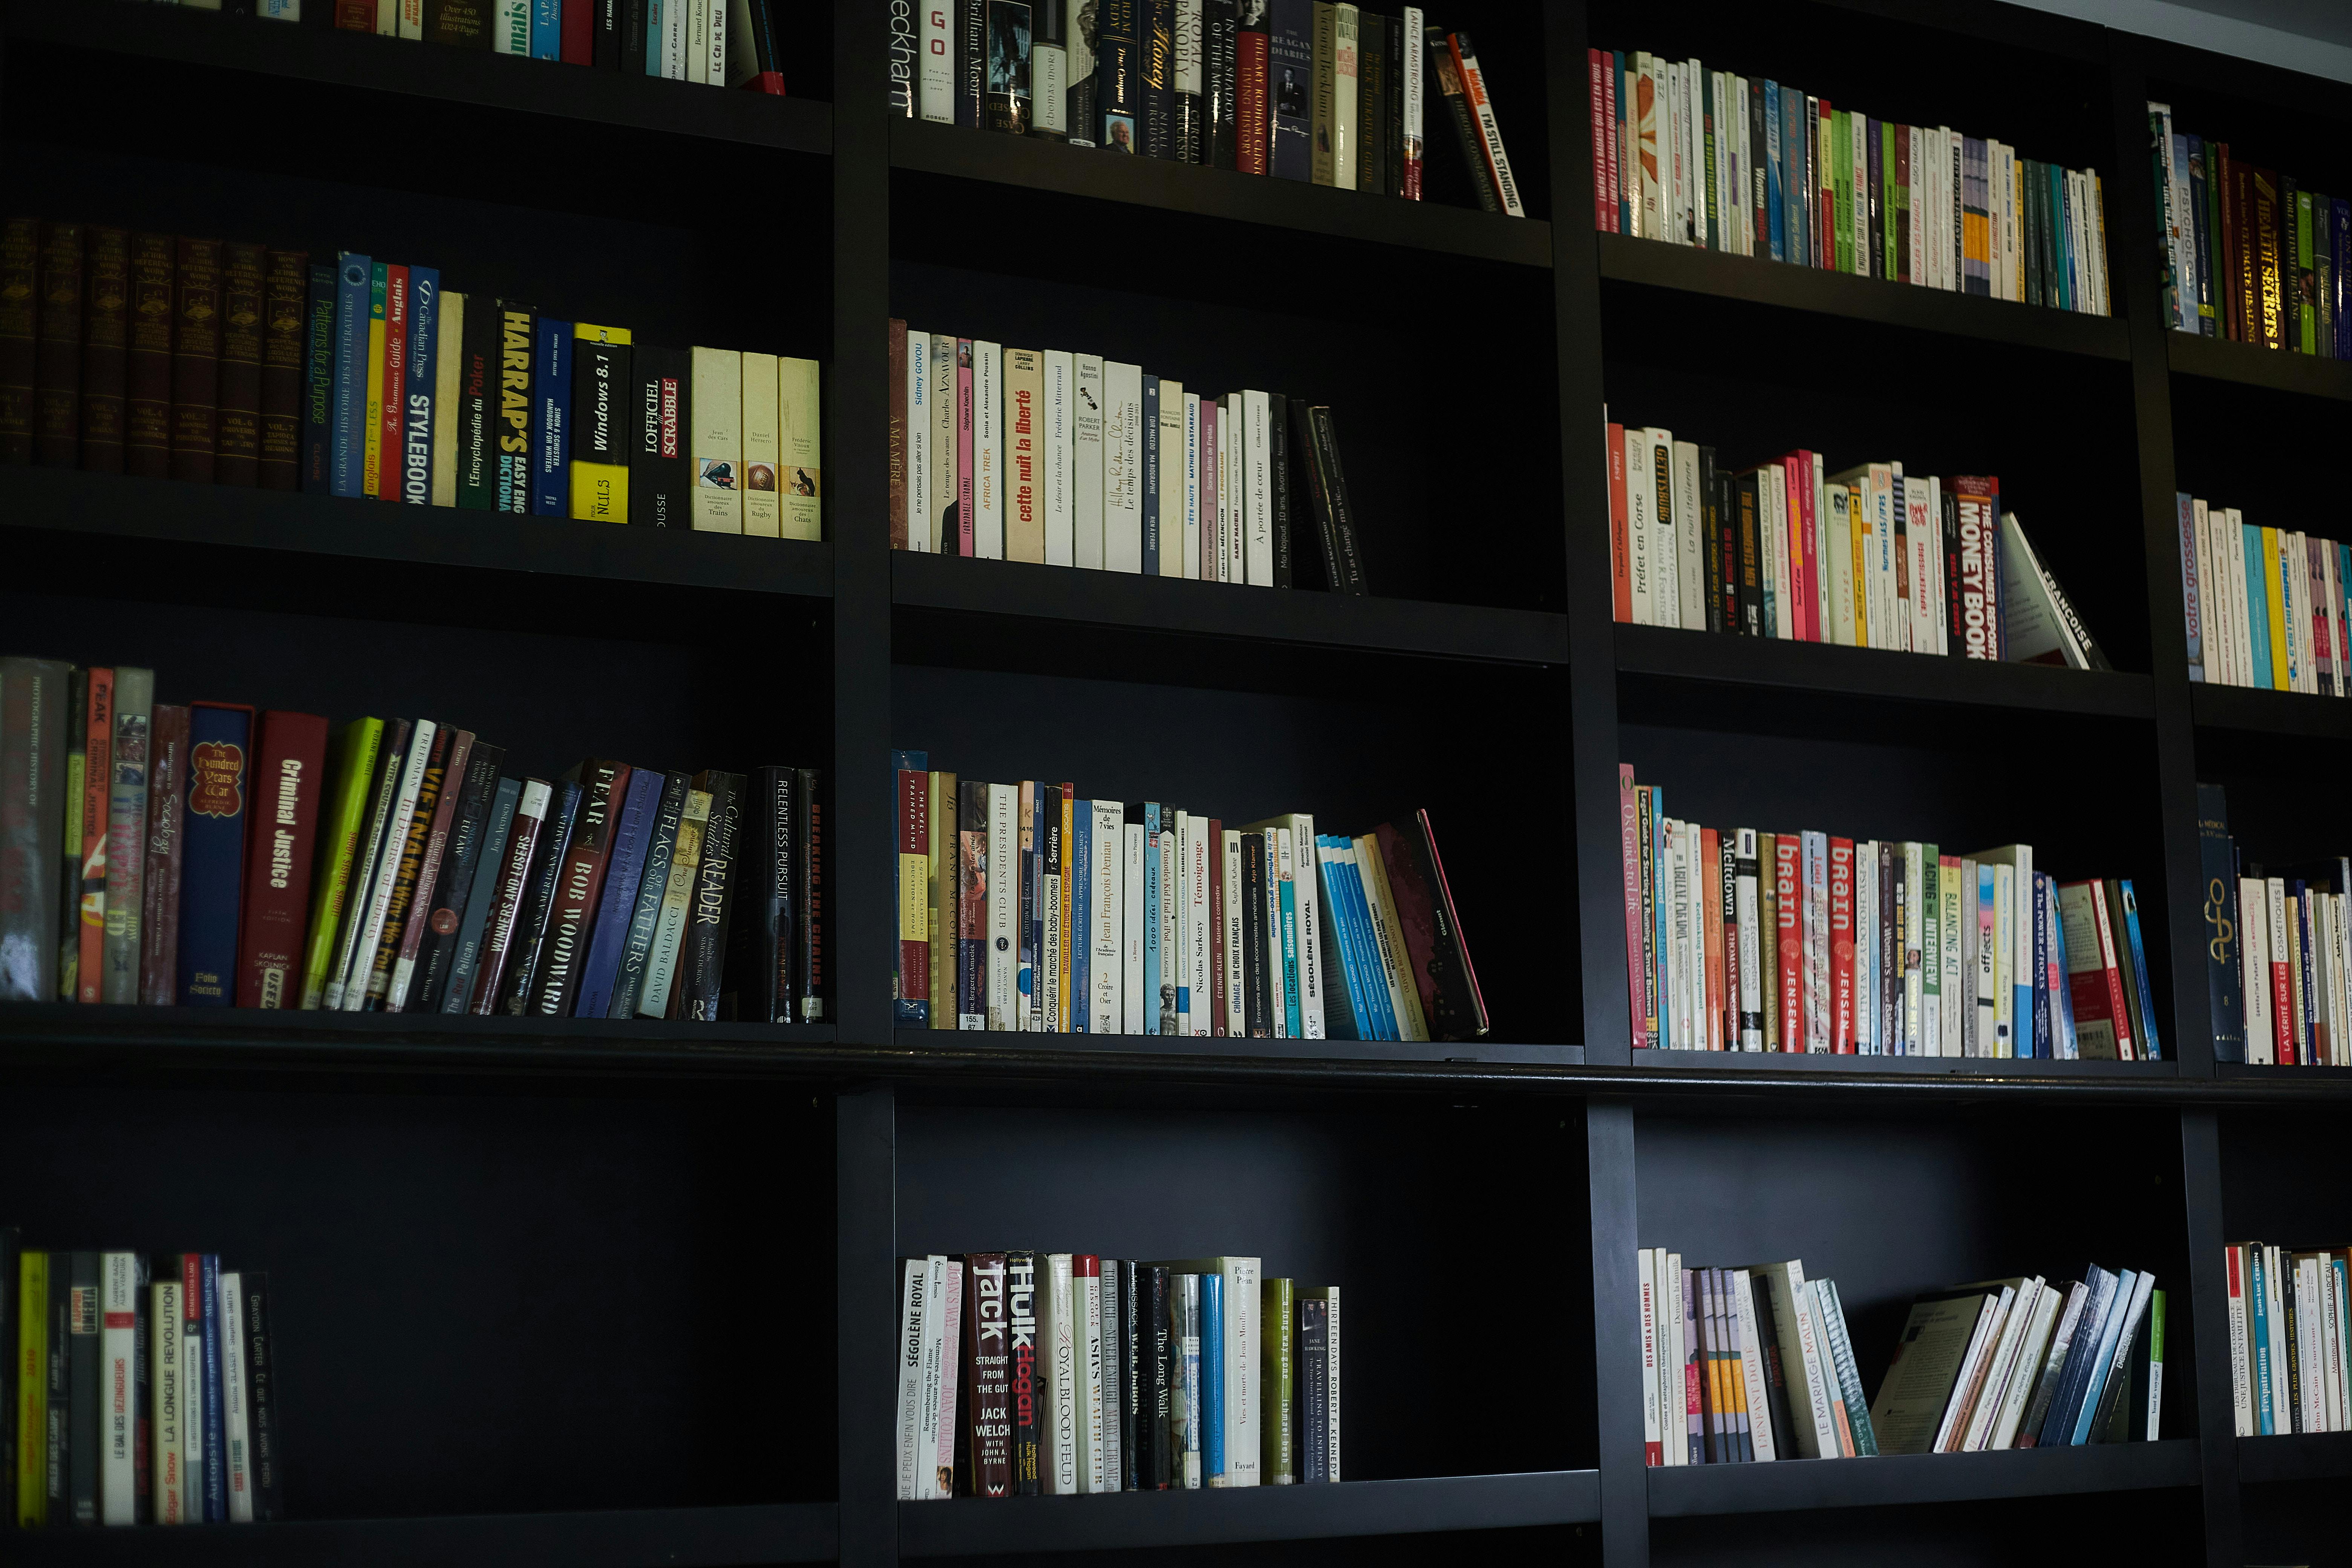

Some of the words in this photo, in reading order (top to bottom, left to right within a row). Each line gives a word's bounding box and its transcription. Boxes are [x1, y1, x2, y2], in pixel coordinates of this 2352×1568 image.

[714, 9, 723, 28] DIEU
[715, 32, 722, 41] DE
[1409, 10, 1419, 39] LANCE
[1271, 37, 1311, 51] REAGAN
[1271, 47, 1311, 61] DIARIES
[713, 63, 721, 72] LE
[1242, 67, 1251, 106] LIVING
[1408, 41, 1419, 101] ARMSTRONG
[1242, 110, 1251, 157] HISTORY
[1485, 126, 1503, 156] STILL
[1493, 156, 1519, 209] STANDING
[2182, 187, 2195, 294] PSYCHOLOGY
[2258, 199, 2273, 263] HEALTH
[391, 278, 404, 325] Anglais
[2262, 265, 2278, 338] SECRETS
[390, 337, 401, 369] Guide
[596, 355, 609, 379] 8.1
[386, 371, 399, 414] Grammar
[468, 354, 485, 397] Poker
[500, 310, 531, 453] HARRAP'S
[475, 398, 482, 407] du
[594, 382, 609, 452] Windows
[645, 380, 658, 453] L'OFFICIEL
[663, 380, 677, 456] SCRABBLE
[1015, 390, 1031, 436] liberté
[387, 416, 398, 435] The
[468, 410, 484, 487] L'Encyclopédie
[1016, 438, 1031, 452] la
[1018, 455, 1032, 482] nuit
[1656, 447, 1671, 524] GETTYSBURG
[597, 479, 610, 516] NULS
[708, 508, 728, 517] Trains
[1019, 485, 1032, 522] cette
[1125, 500, 1134, 510] Le
[1256, 488, 1263, 499] de
[1635, 494, 1644, 530] Corse
[751, 510, 772, 519] Rugby
[1256, 503, 1266, 533] portée
[1254, 534, 1264, 544] À
[1638, 535, 1645, 551] en
[1959, 501, 1983, 591] MONEY
[2181, 500, 2198, 589] grossesse
[1637, 555, 1646, 594] Préfet
[1964, 592, 1987, 660] BOOK
[2185, 593, 2199, 638] votre
[276, 759, 302, 826] Criminal
[586, 767, 615, 825] FEAR
[778, 780, 788, 851] RELENTLESS
[270, 827, 296, 888] Justice
[651, 813, 677, 869] FLAGS
[812, 804, 821, 886] BREAKING
[1049, 826, 1058, 863] Serrière
[568, 862, 593, 901] BOB
[696, 858, 727, 925] READER
[777, 852, 788, 901] PURSUIT
[1194, 841, 1203, 907] Témoignage
[1723, 838, 1736, 916] Meltdown
[490, 902, 514, 953] WINNERS
[504, 876, 521, 901] AND
[513, 835, 531, 877] LOSERS
[812, 891, 821, 918] THE
[1049, 878, 1060, 921] baby-boomers
[626, 894, 658, 974] FATHERS
[1048, 922, 1057, 934] des
[1195, 921, 1204, 957] Sarkozy
[2274, 888, 2285, 961] COSMÉTIQUES
[541, 907, 582, 1016] WOODWARD
[651, 967, 665, 1004] DAVID
[660, 906, 679, 963] BALDACCI
[812, 923, 821, 986] CHAINS
[1048, 936, 1057, 965] marché
[1305, 939, 1315, 997] SÉGOLÈNE
[1049, 966, 1055, 977] le
[1046, 980, 1059, 1023] Conquérir
[1786, 969, 1797, 1030] JENSEN
[2280, 982, 2288, 1003] SUR
[2281, 1004, 2290, 1038] VÉRITÉ
[2283, 1041, 2290, 1052] LA
[912, 1272, 924, 1307] ROYAL
[1234, 1266, 1254, 1275] Pierre
[2326, 1263, 2334, 1300] MARCEAU
[1009, 1266, 1036, 1350] Hulk
[1643, 1282, 1651, 1312] HOMMES
[163, 1286, 175, 1365] REVOLUTION
[908, 1309, 921, 1367] SÉGOLÈNE
[1156, 1329, 1167, 1352] The
[1801, 1311, 1816, 1355] MALIN
[975, 1356, 1008, 1365] STRAIGHT
[982, 1370, 1004, 1379] FROM
[1155, 1354, 1167, 1386] Long
[2330, 1337, 2339, 1374] Menteuse
[165, 1370, 175, 1423] LONGUE
[977, 1384, 992, 1393] THE
[994, 1384, 1009, 1393] GUT
[1012, 1345, 1035, 1426] Hogan
[1158, 1388, 1167, 1418] Walk
[1808, 1355, 1826, 1419] MARIAGE
[975, 1425, 1010, 1436] WELCH
[981, 1408, 1007, 1419] JACK
[1331, 1417, 1337, 1426] F.
[1820, 1420, 1830, 1436] LE
[166, 1426, 174, 1442] LA
[165, 1452, 175, 1485] Snow
[165, 1487, 177, 1525] Edgar
